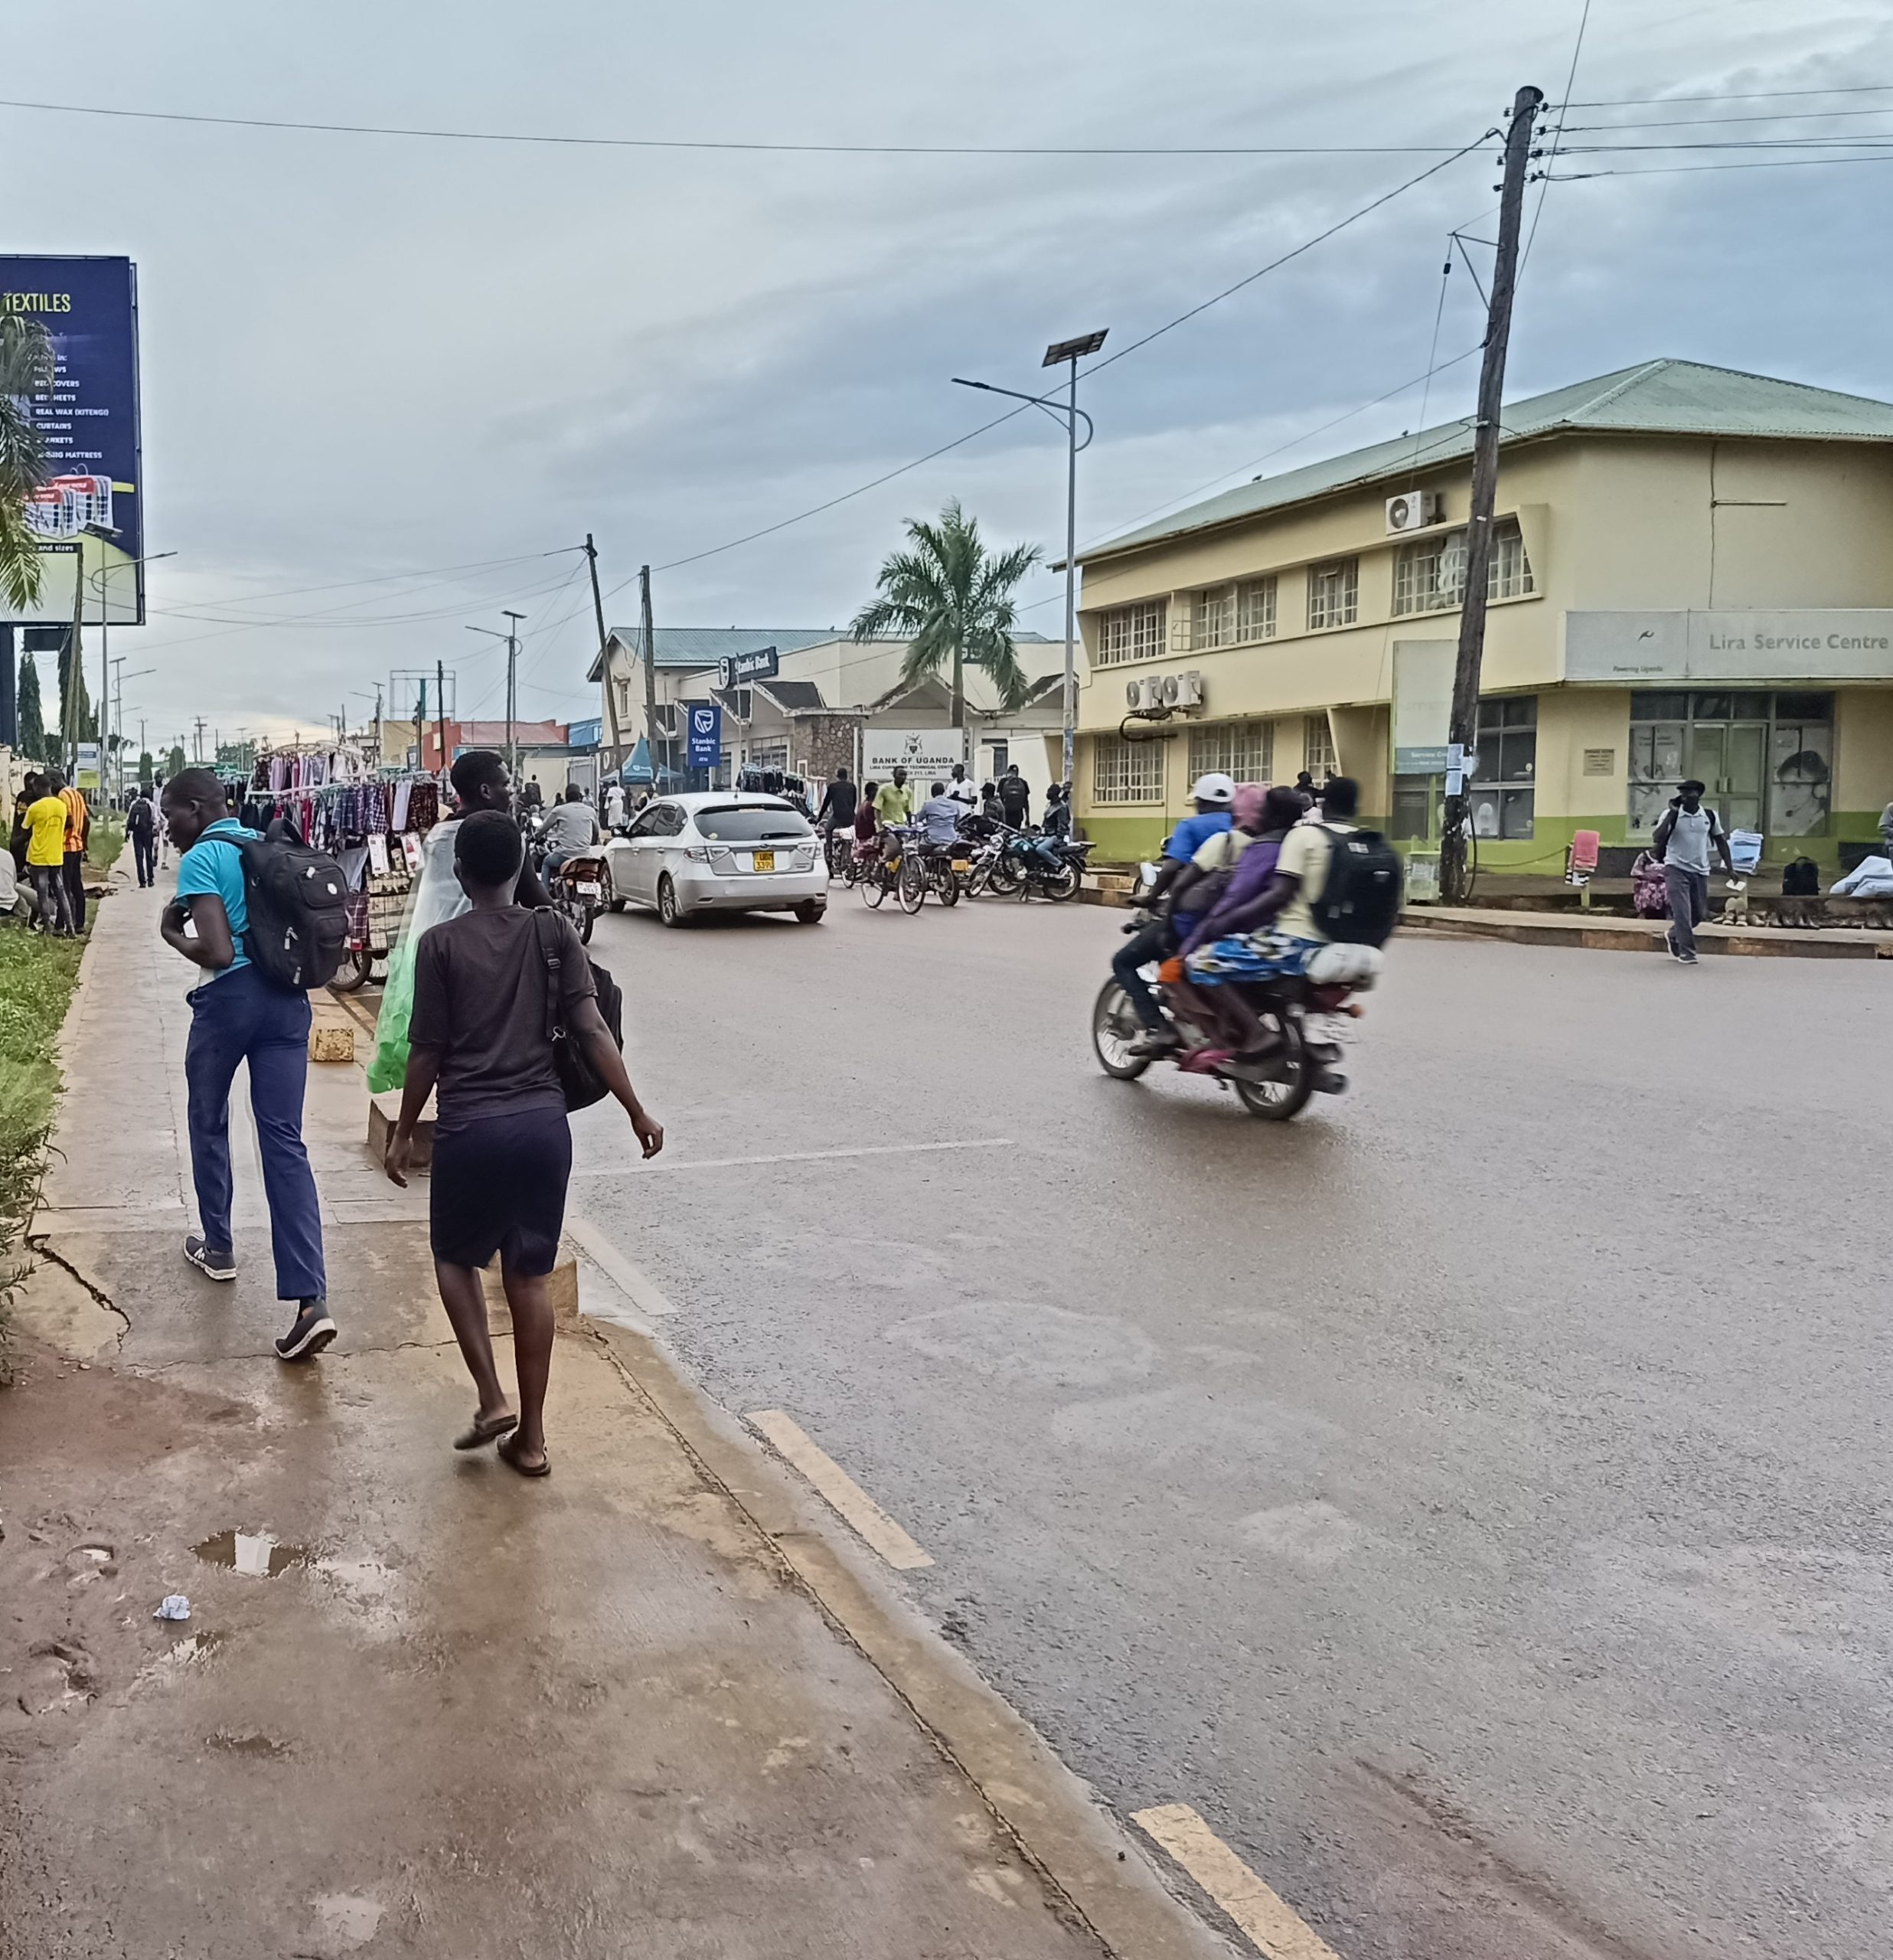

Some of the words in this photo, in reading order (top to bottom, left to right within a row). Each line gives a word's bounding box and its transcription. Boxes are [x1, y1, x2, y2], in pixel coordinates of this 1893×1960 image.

[3, 293, 71, 312] TEXTILES
[1709, 634, 1746, 649] Lira
[1754, 634, 1821, 649] Service
[1826, 634, 1889, 649] Centre
[755, 653, 770, 670] Bank
